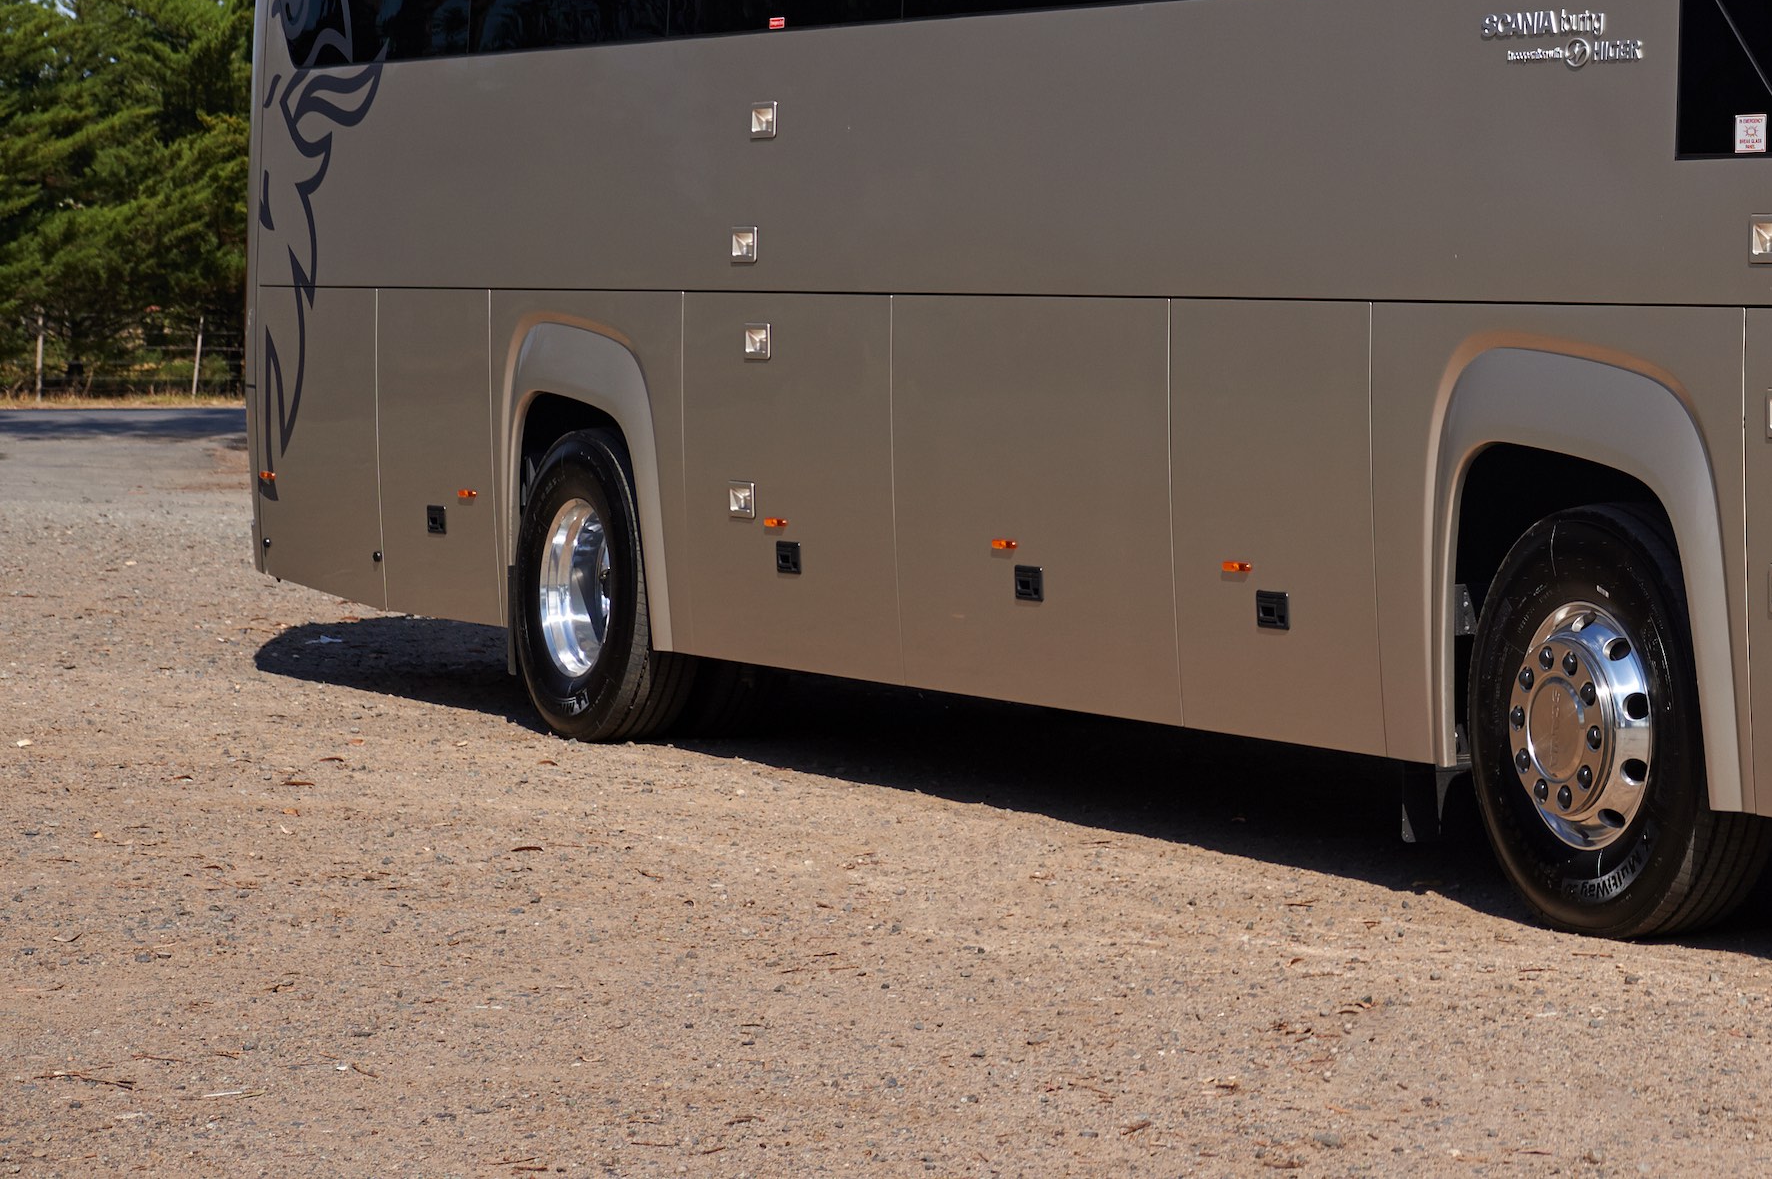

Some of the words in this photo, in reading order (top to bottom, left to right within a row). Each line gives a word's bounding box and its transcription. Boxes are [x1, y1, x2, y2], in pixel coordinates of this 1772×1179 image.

[1481, 10, 1558, 38] SCANIA
[1593, 39, 1643, 62] HIGER
[1580, 851, 1644, 899] MultiWay
